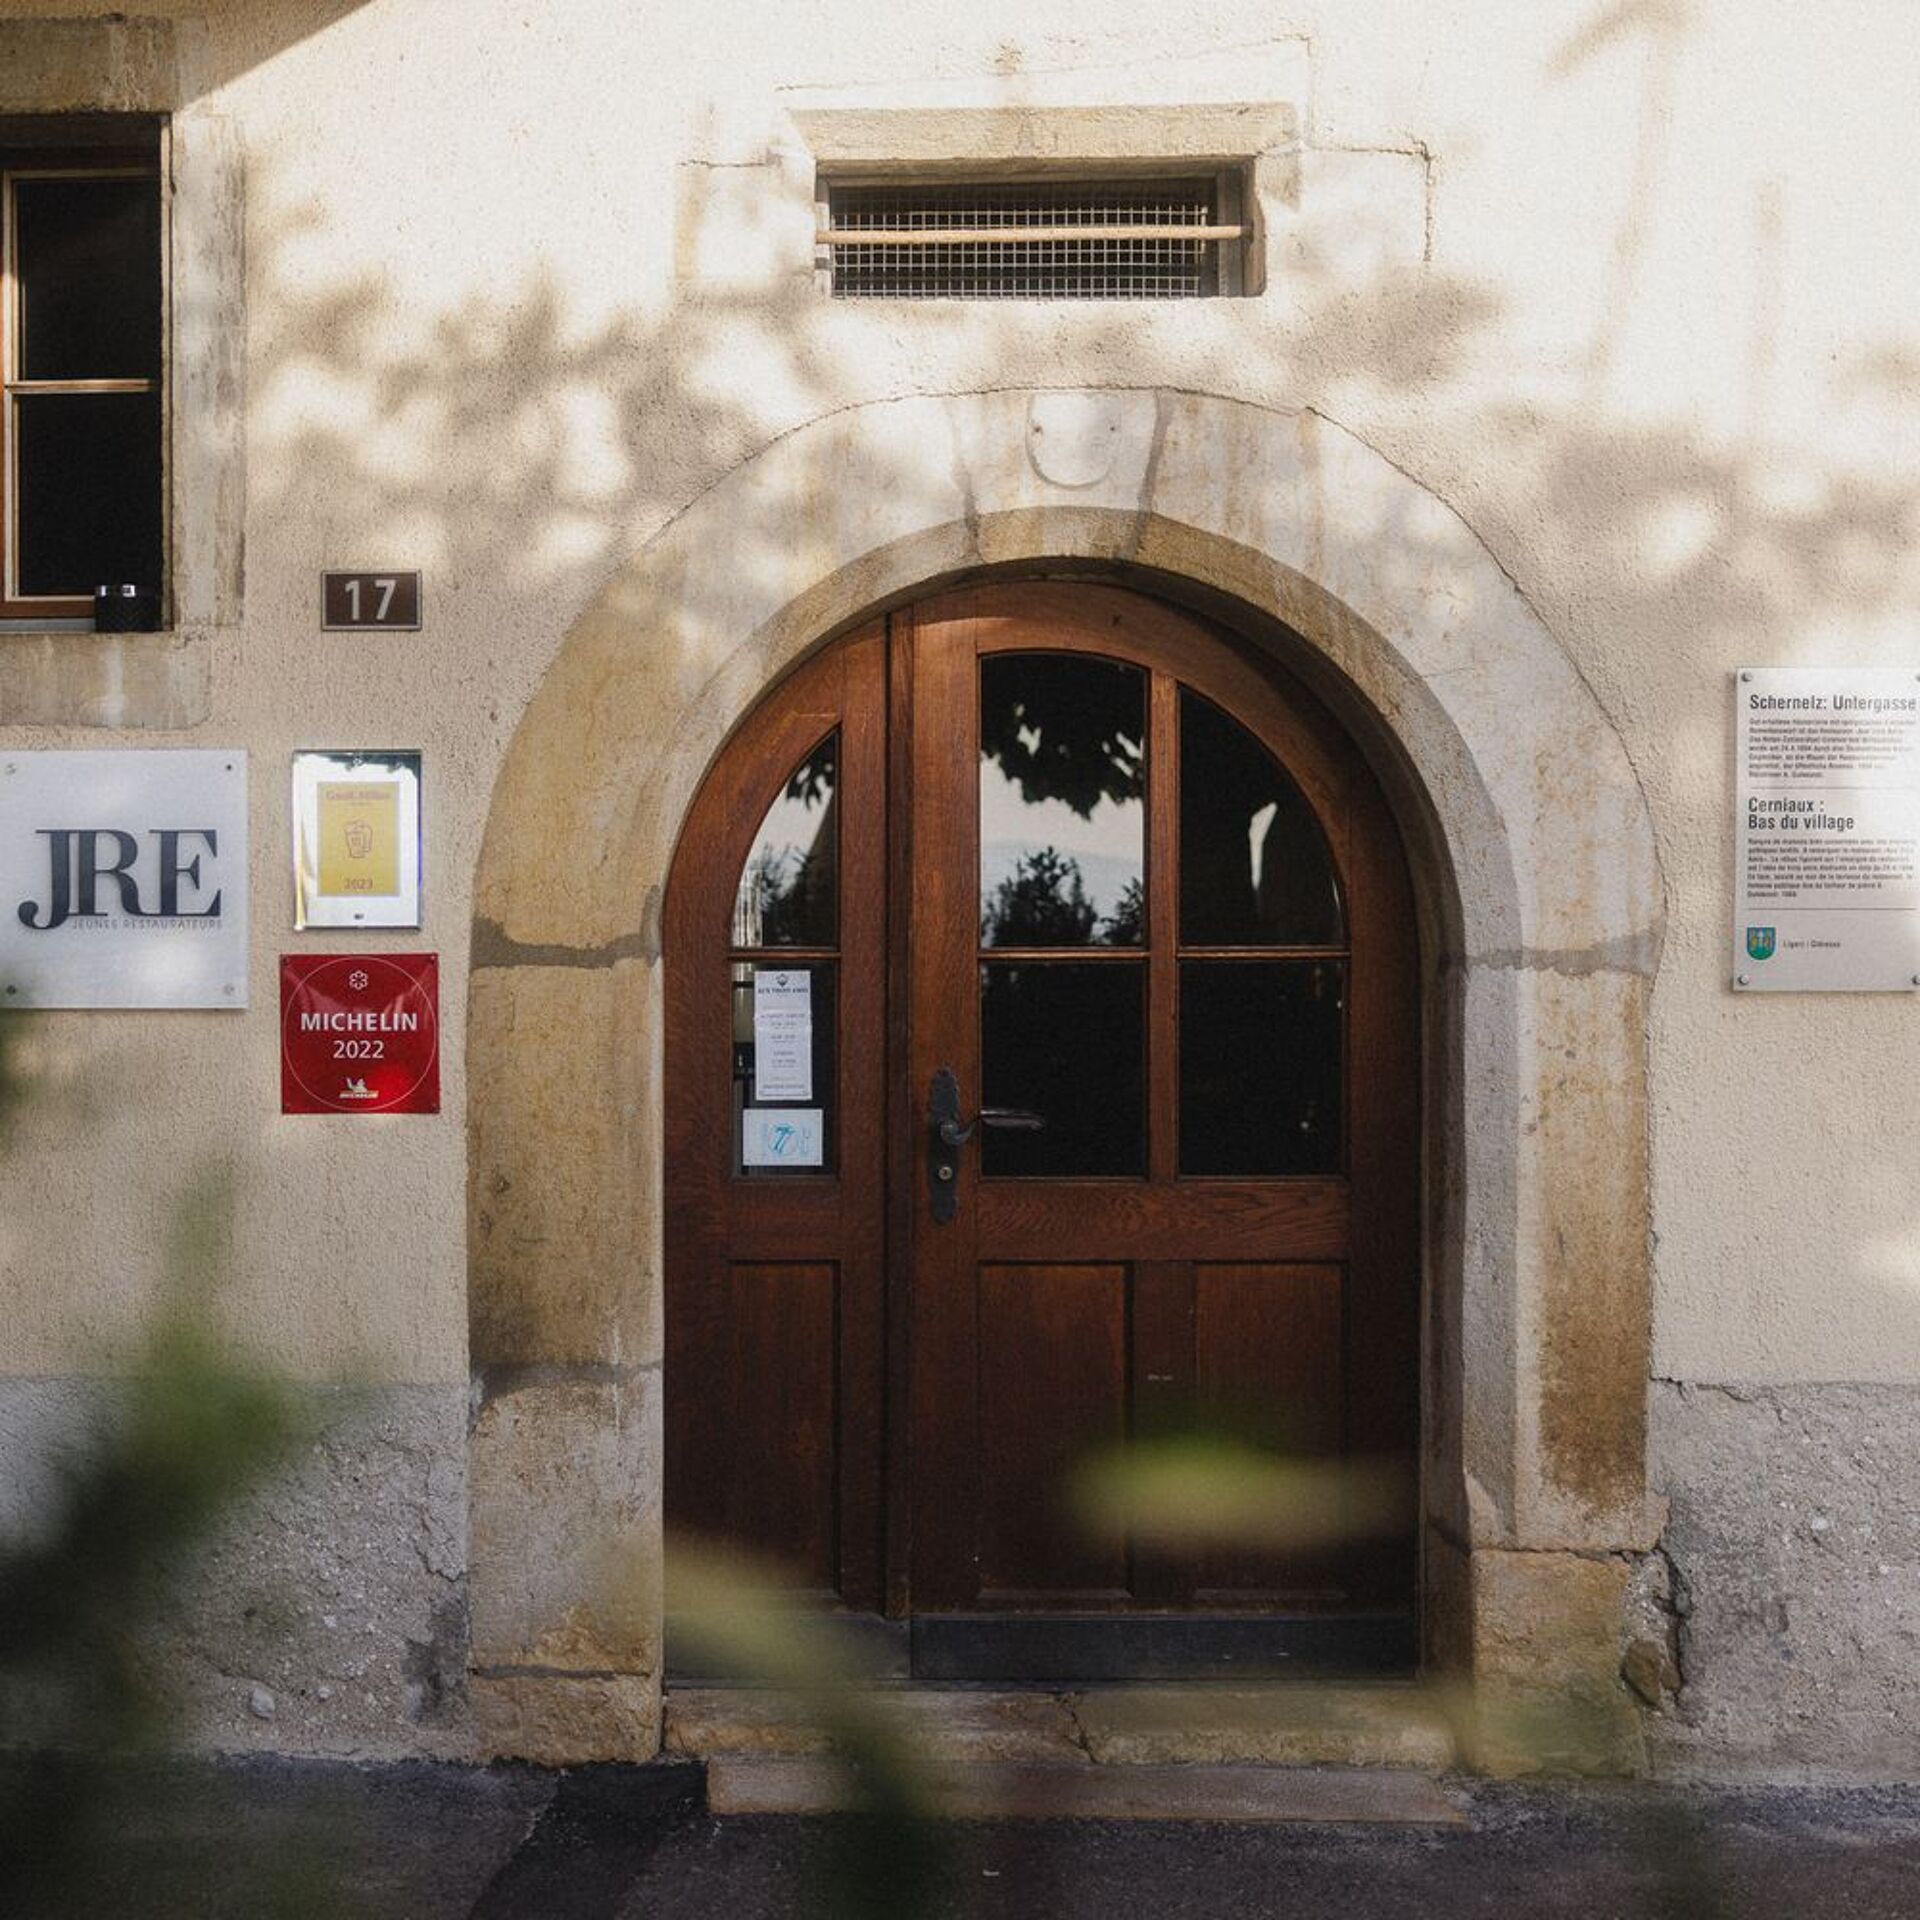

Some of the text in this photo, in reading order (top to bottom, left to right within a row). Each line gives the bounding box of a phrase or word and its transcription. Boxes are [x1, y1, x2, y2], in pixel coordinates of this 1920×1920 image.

[345, 580, 396, 620] 17
[1750, 694, 1917, 712] Schernelz: Untergasse
[1748, 797, 1814, 813] Cerniaux
[1748, 814, 1855, 832] Bas du village
[17, 829, 221, 930] JRE
[344, 878, 373, 890] 2023
[300, 1012, 418, 1032] MICHELIN
[333, 1040, 385, 1059] 2022
